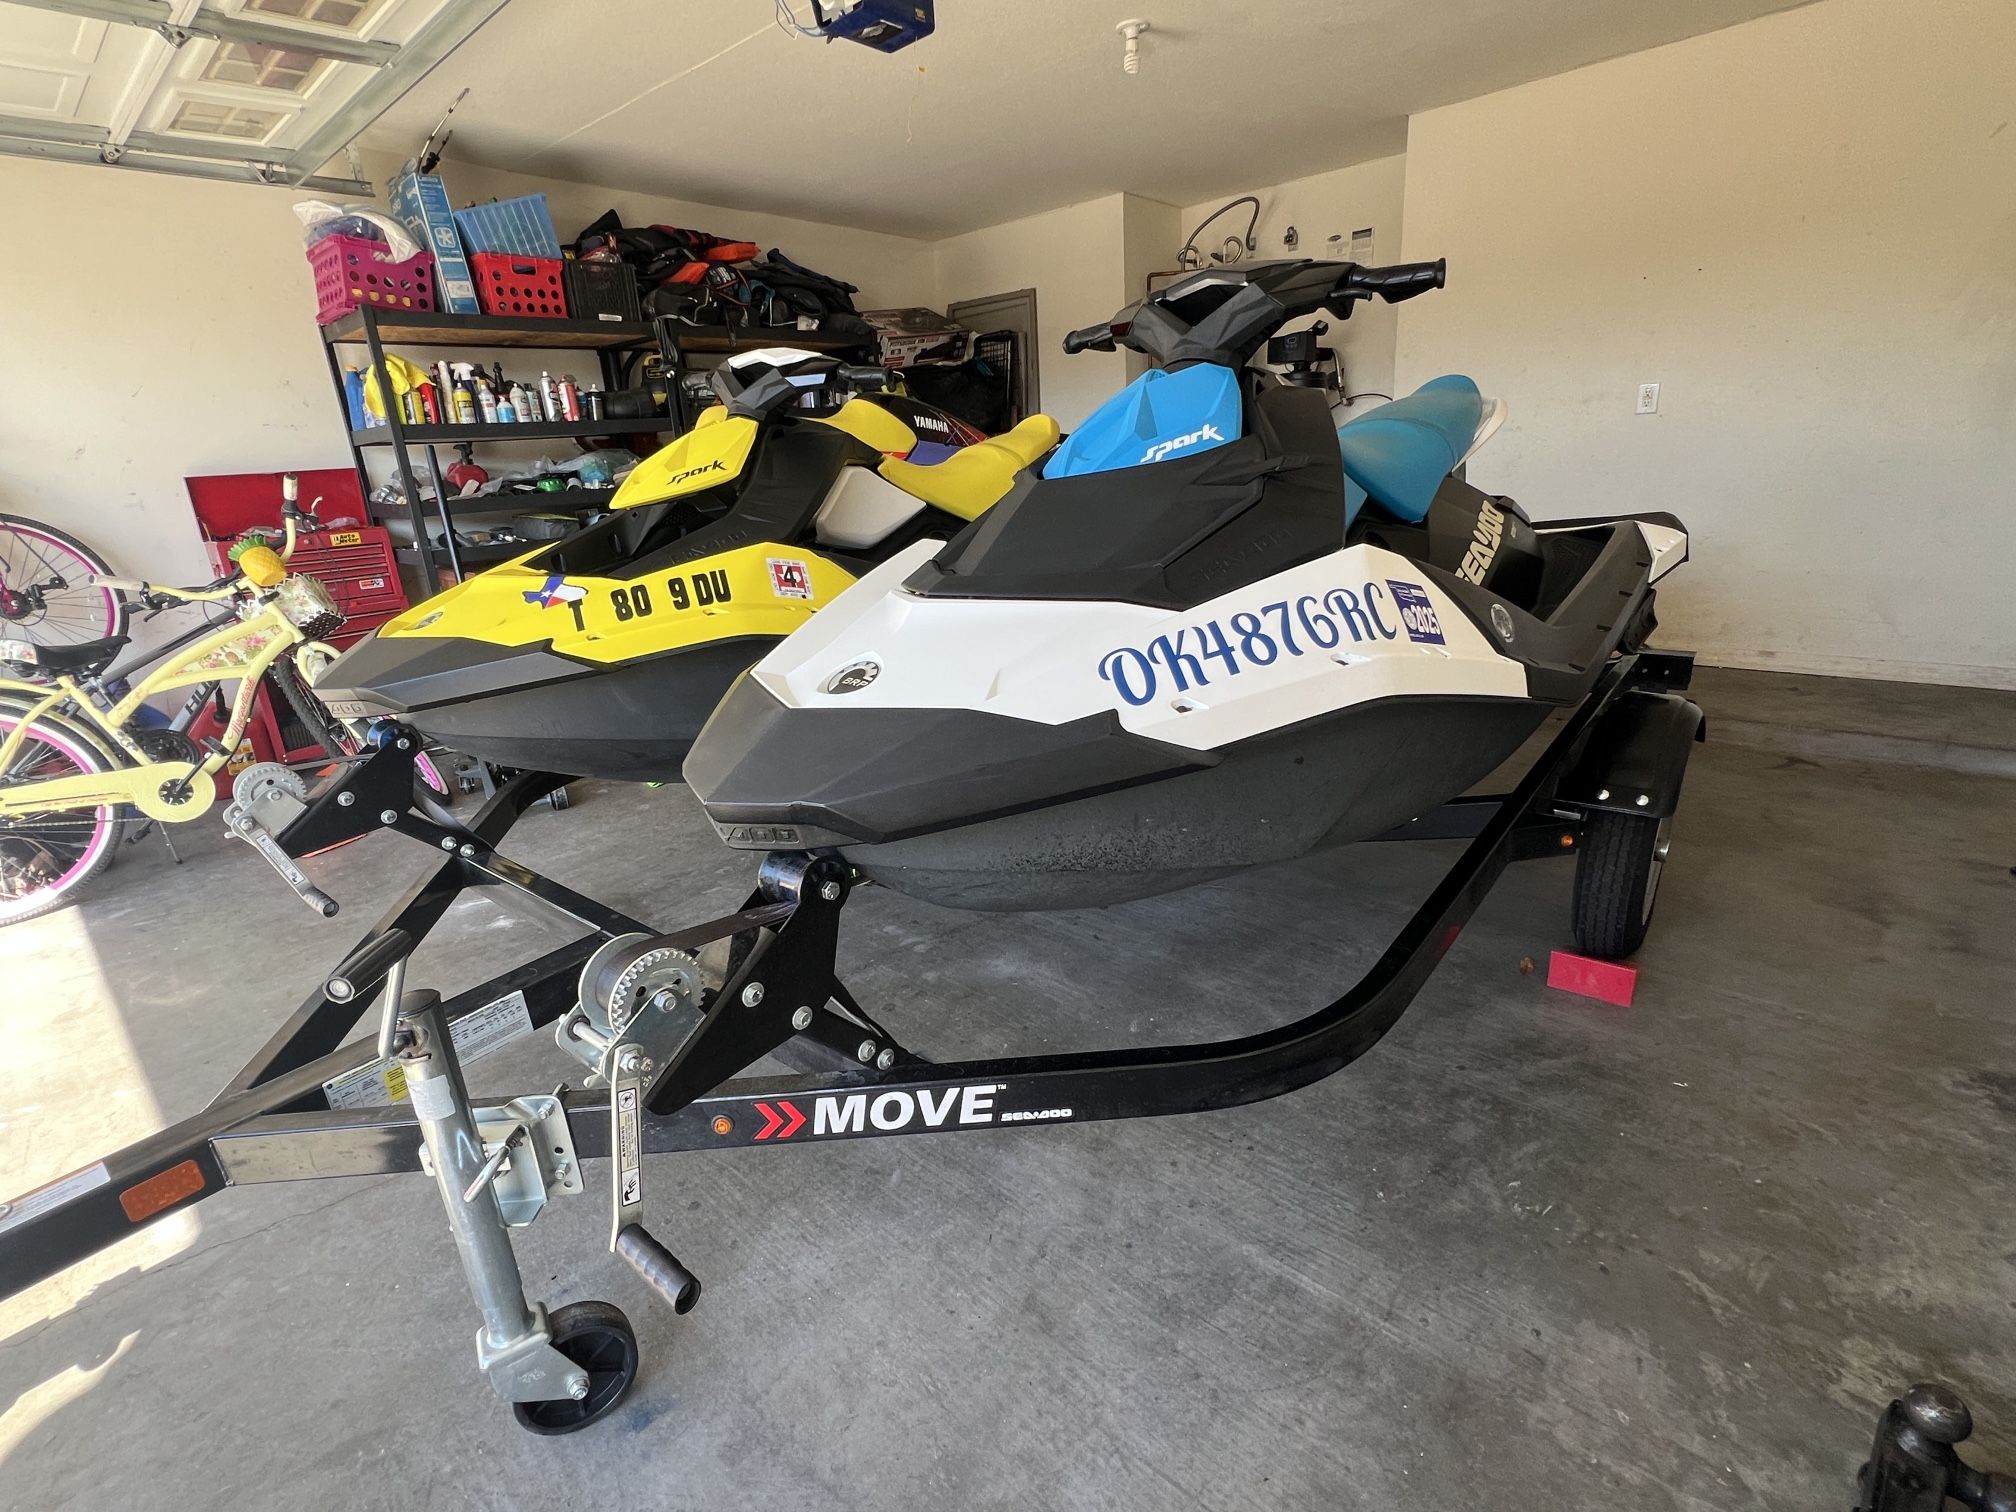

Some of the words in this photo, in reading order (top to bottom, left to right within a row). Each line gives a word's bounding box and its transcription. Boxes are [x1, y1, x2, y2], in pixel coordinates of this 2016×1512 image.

[914, 415, 949, 433] YAMAHA
[784, 566, 797, 588] 4
[568, 599, 585, 632] T
[610, 584, 652, 622] 80
[667, 577, 690, 610] 9
[692, 569, 732, 606] DU
[1411, 604, 1441, 635] 2025
[1098, 582, 1397, 706] OK4876RC
[841, 677, 869, 687] BRP
[813, 1085, 997, 1135] MOVE
